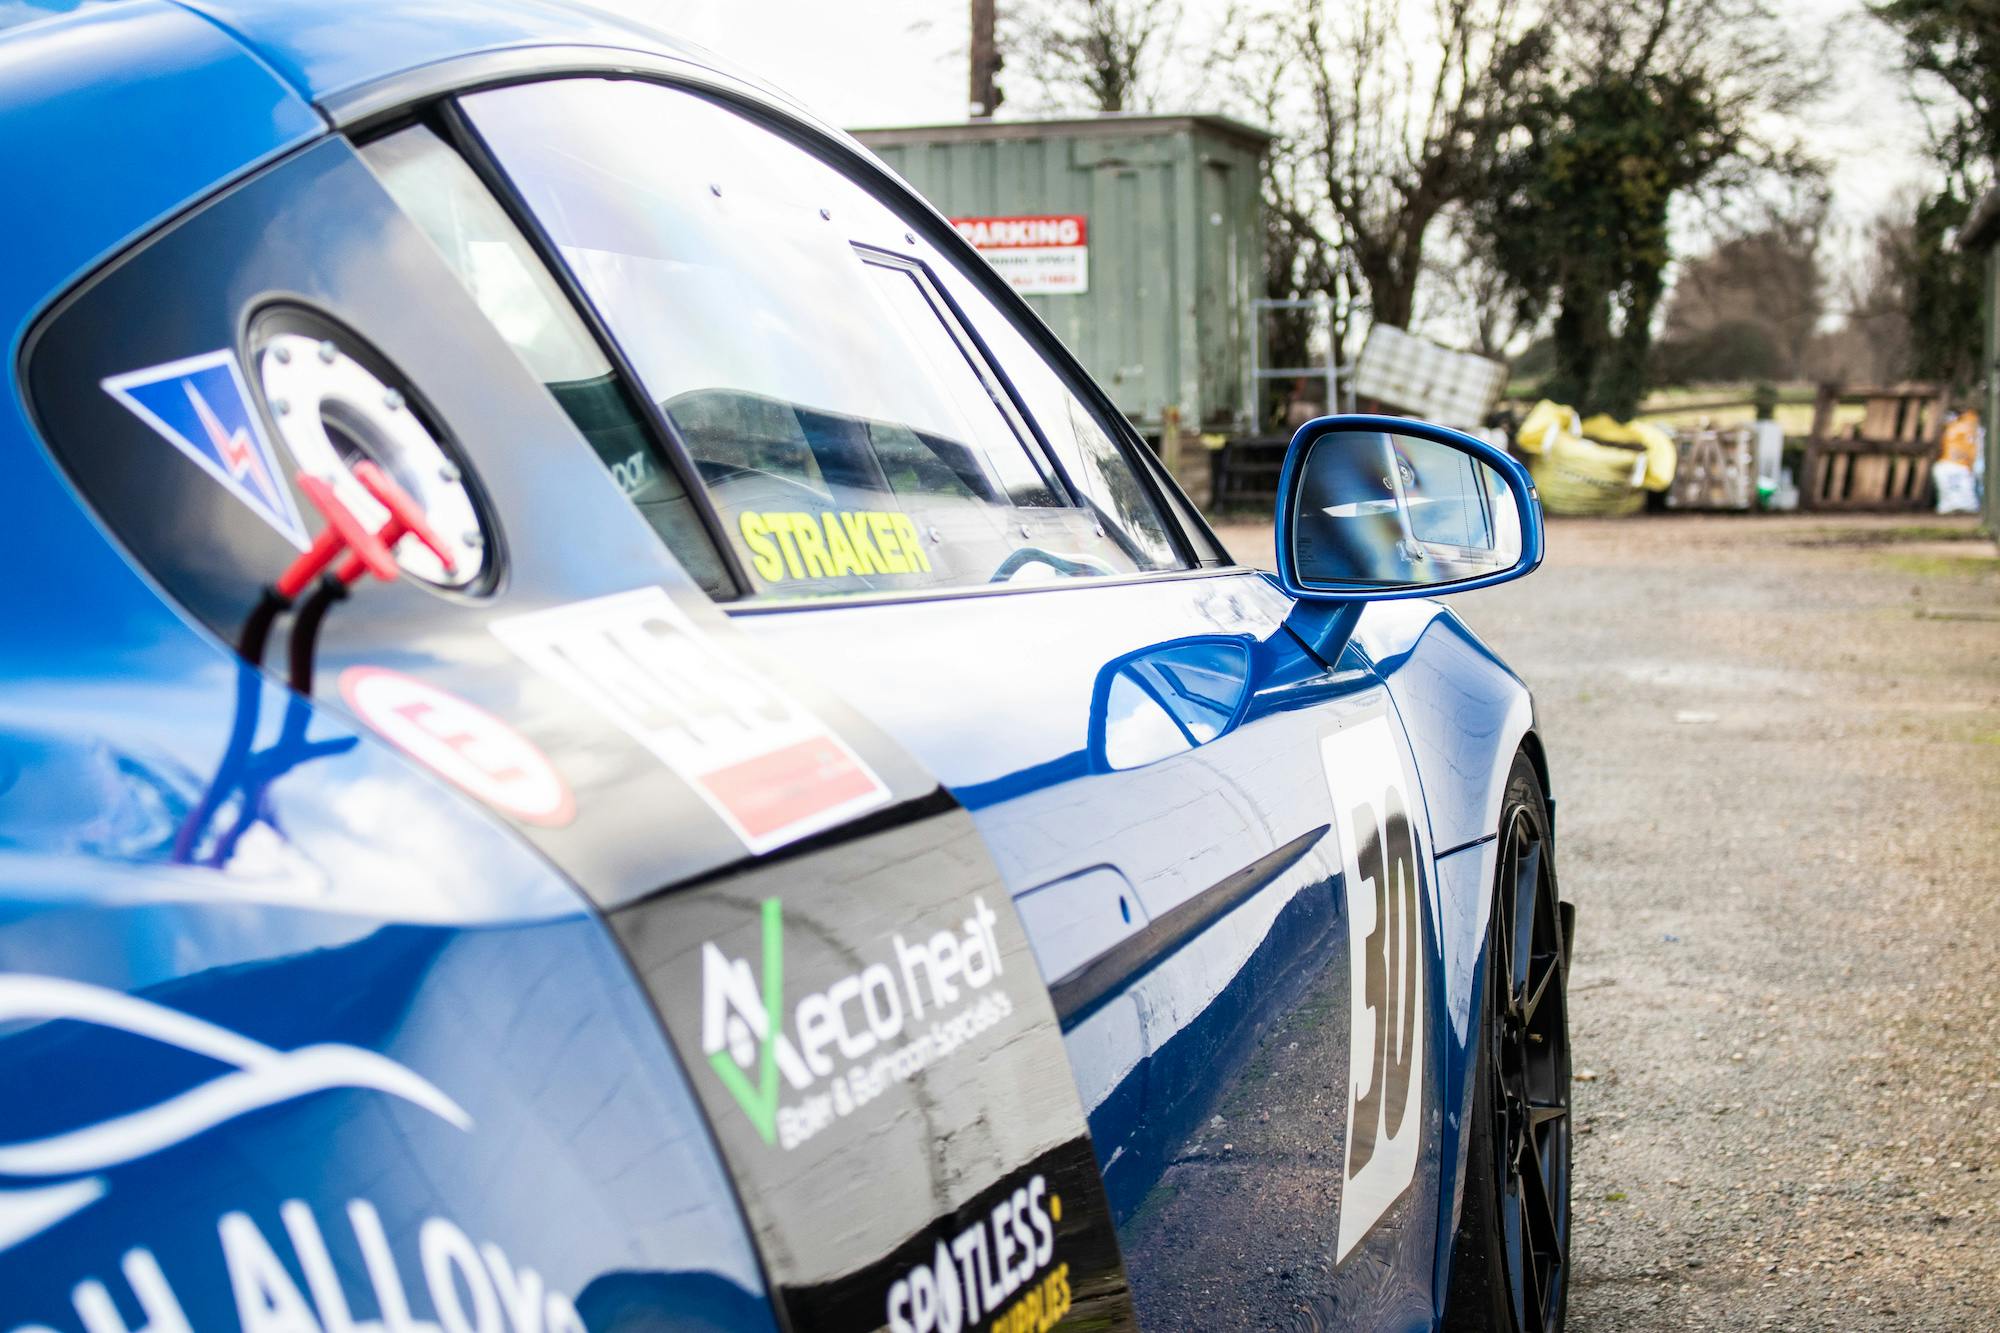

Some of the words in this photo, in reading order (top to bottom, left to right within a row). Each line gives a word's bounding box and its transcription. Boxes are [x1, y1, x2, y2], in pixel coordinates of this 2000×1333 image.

[957, 219, 1079, 246] PARKING
[738, 510, 932, 582] STRAKER
[795, 962, 903, 1076] eco
[893, 896, 1003, 1021] heat
[1349, 785, 1418, 1180] 30
[886, 1174, 1054, 1333] SPOTLESS
